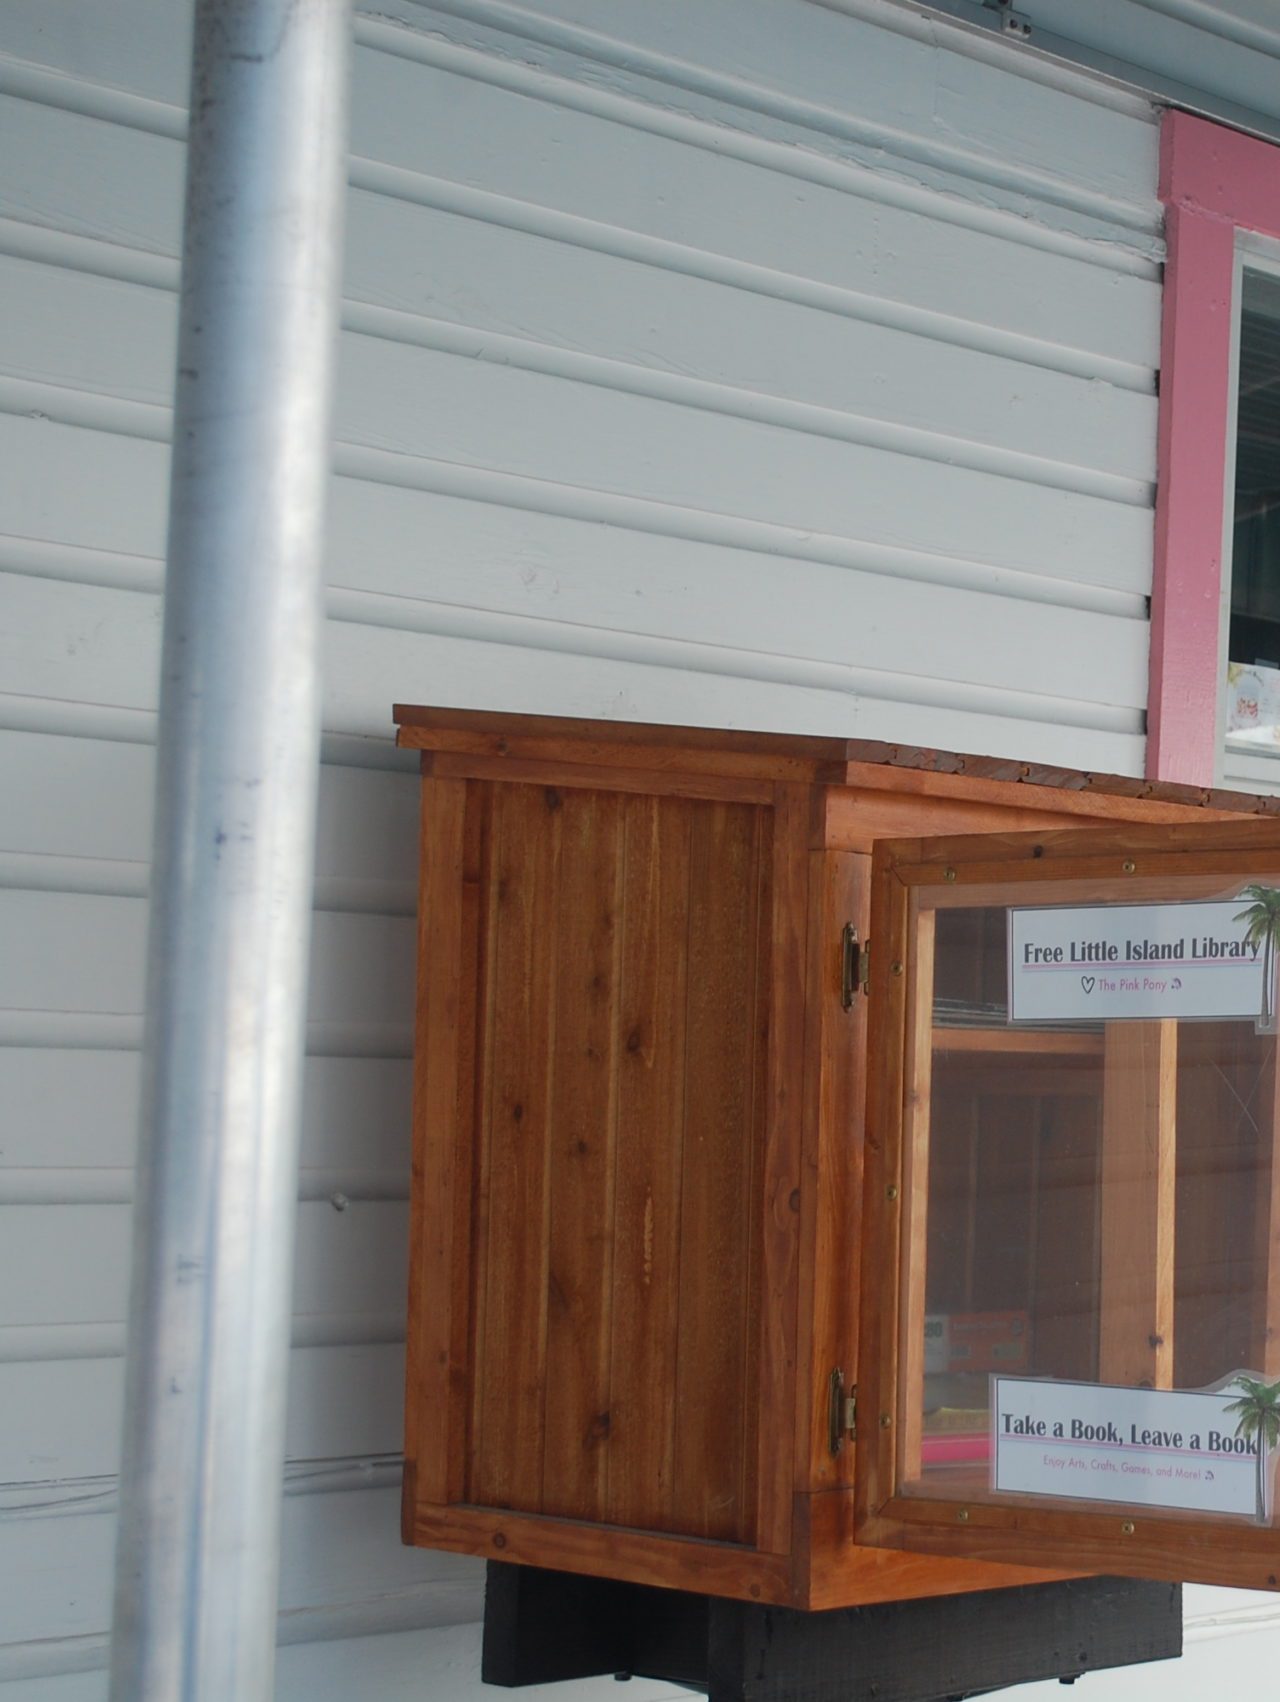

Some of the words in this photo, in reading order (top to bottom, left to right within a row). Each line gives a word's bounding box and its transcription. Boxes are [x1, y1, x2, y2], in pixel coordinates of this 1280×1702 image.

[1023, 942, 1063, 963] Free
[1070, 940, 1119, 962] Little
[1125, 939, 1184, 961] Island
[1191, 937, 1262, 961] Library
[1098, 978, 1115, 991] The
[1119, 978, 1140, 991] Pink
[1143, 978, 1167, 992] Pony
[1001, 1413, 1047, 1437] Take
[1053, 1422, 1064, 1438] a
[1071, 1418, 1124, 1447] Book,
[1131, 1424, 1183, 1448] Leave
[1189, 1434, 1201, 1450] a
[1208, 1431, 1258, 1455] Book
[1043, 1454, 1065, 1470] Enjoy
[1068, 1456, 1087, 1470] Arts,
[1091, 1459, 1118, 1473] Crafts,
[1121, 1462, 1153, 1476] Games,
[1156, 1465, 1173, 1478] and
